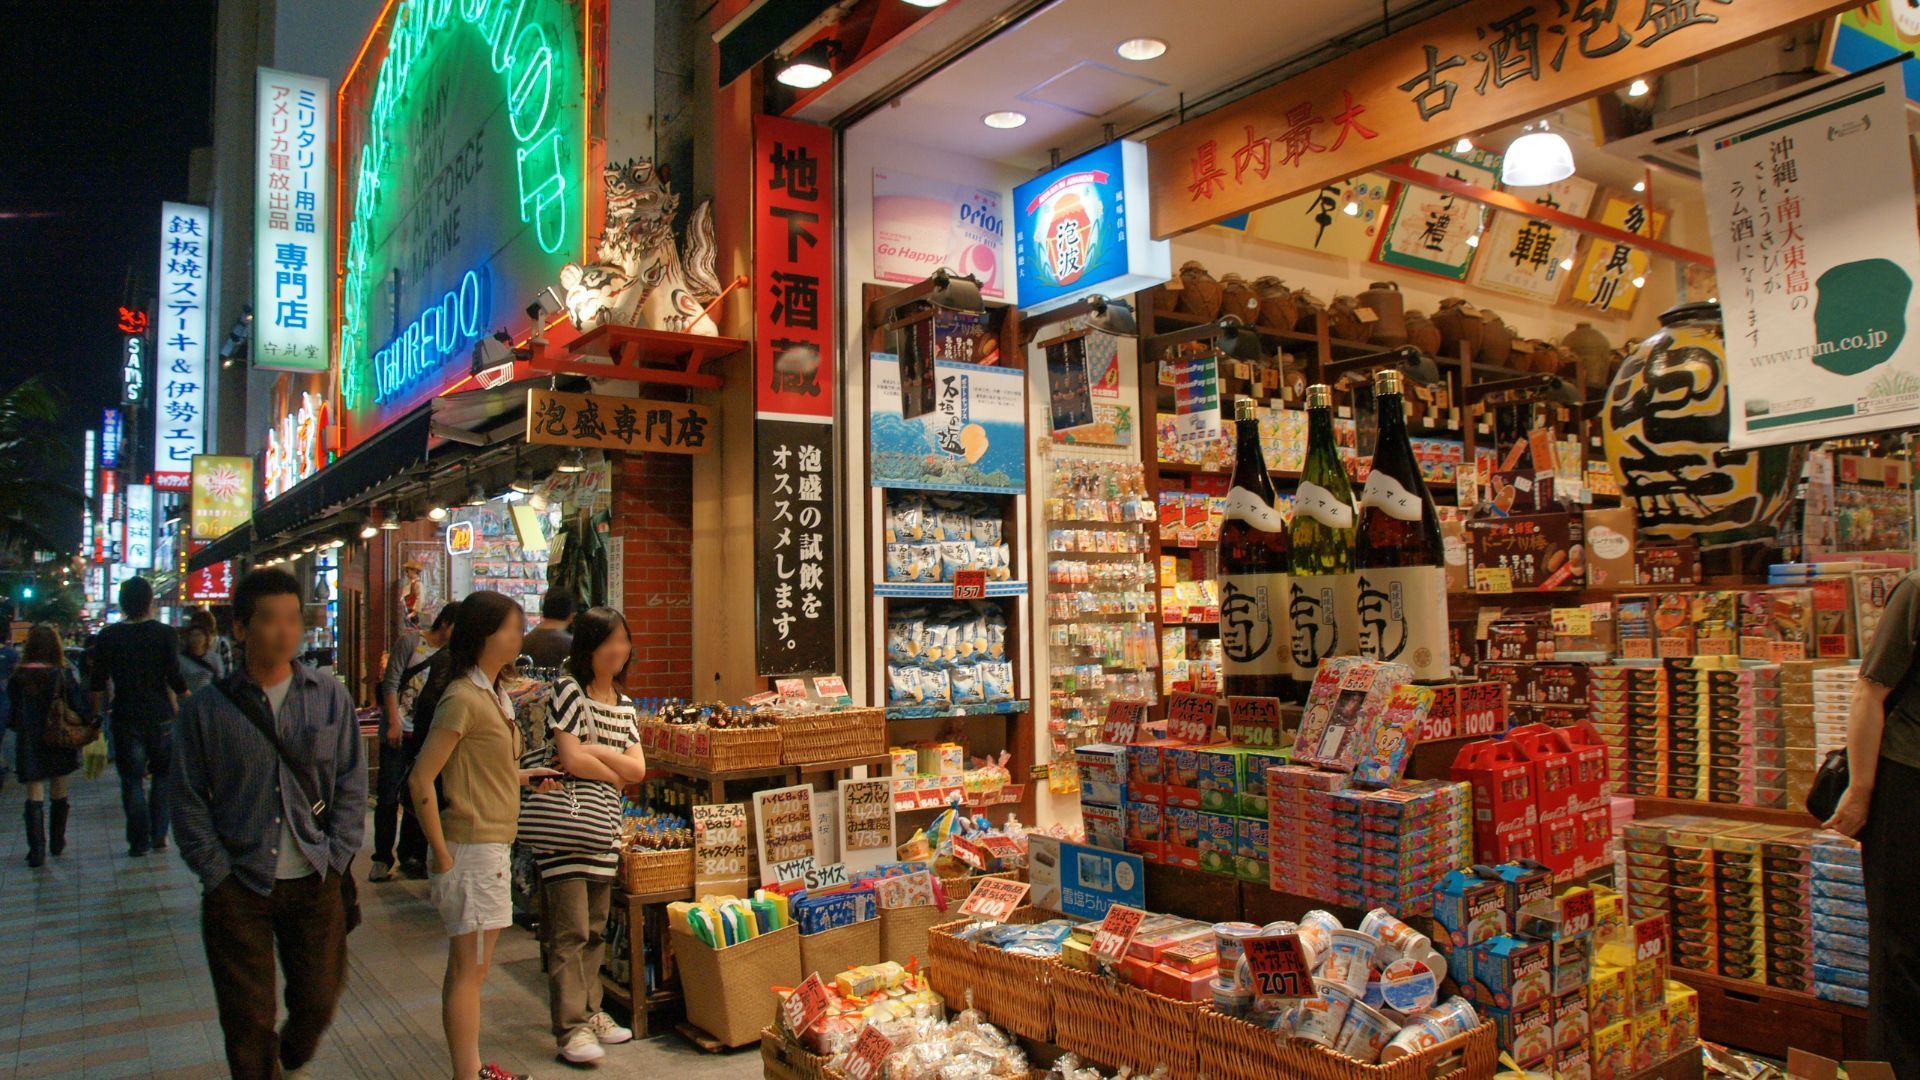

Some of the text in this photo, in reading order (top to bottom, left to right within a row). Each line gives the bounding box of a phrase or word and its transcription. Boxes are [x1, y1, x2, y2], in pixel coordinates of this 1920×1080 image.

[415, 76, 452, 149] ARMY
[268, 84, 291, 231] アメリカ軍放出品
[1188, 90, 1378, 202] 県内最大
[294, 89, 317, 234] ミリタリー用品
[436, 130, 485, 206] FORCE
[1754, 160, 1783, 295] さとうきびが
[1768, 135, 1810, 311] 沖縄・南大東島の
[412, 207, 461, 286] MARINE
[878, 243, 948, 265] Go Happy!
[1058, 221, 1080, 277] 泡波
[1589, 204, 1646, 311] 多良川
[769, 142, 822, 397] 地下酒蔵
[1729, 180, 1763, 348] ラム酒になります
[275, 242, 308, 330] 専門店
[1750, 328, 1889, 368] www.rum.co.jp
[535, 399, 708, 448] 泡盛専門店
[938, 376, 966, 456] 石垣の塩
[798, 445, 823, 619] 泡盛の試飲を
[772, 444, 796, 650] オススメします。
[957, 586, 980, 597] 157
[1172, 696, 1214, 715] ハイチュウ
[1233, 702, 1277, 718] ハイチュウ
[1112, 723, 1136, 744] 399
[1177, 722, 1207, 742] 399
[1244, 726, 1274, 744] 504
[1423, 718, 1451, 740] 500
[1465, 711, 1494, 735] 1000
[855, 802, 882, 819] 420
[705, 828, 740, 846] 504
[706, 819, 732, 831] Bag
[775, 822, 801, 836] 504
[855, 832, 881, 848] 735
[705, 859, 740, 875] 840
[805, 863, 846, 889] Sサイズ
[972, 898, 1006, 917] 100
[1563, 913, 1589, 937] 630
[1637, 937, 1662, 961] 630
[1257, 972, 1299, 996] 207
